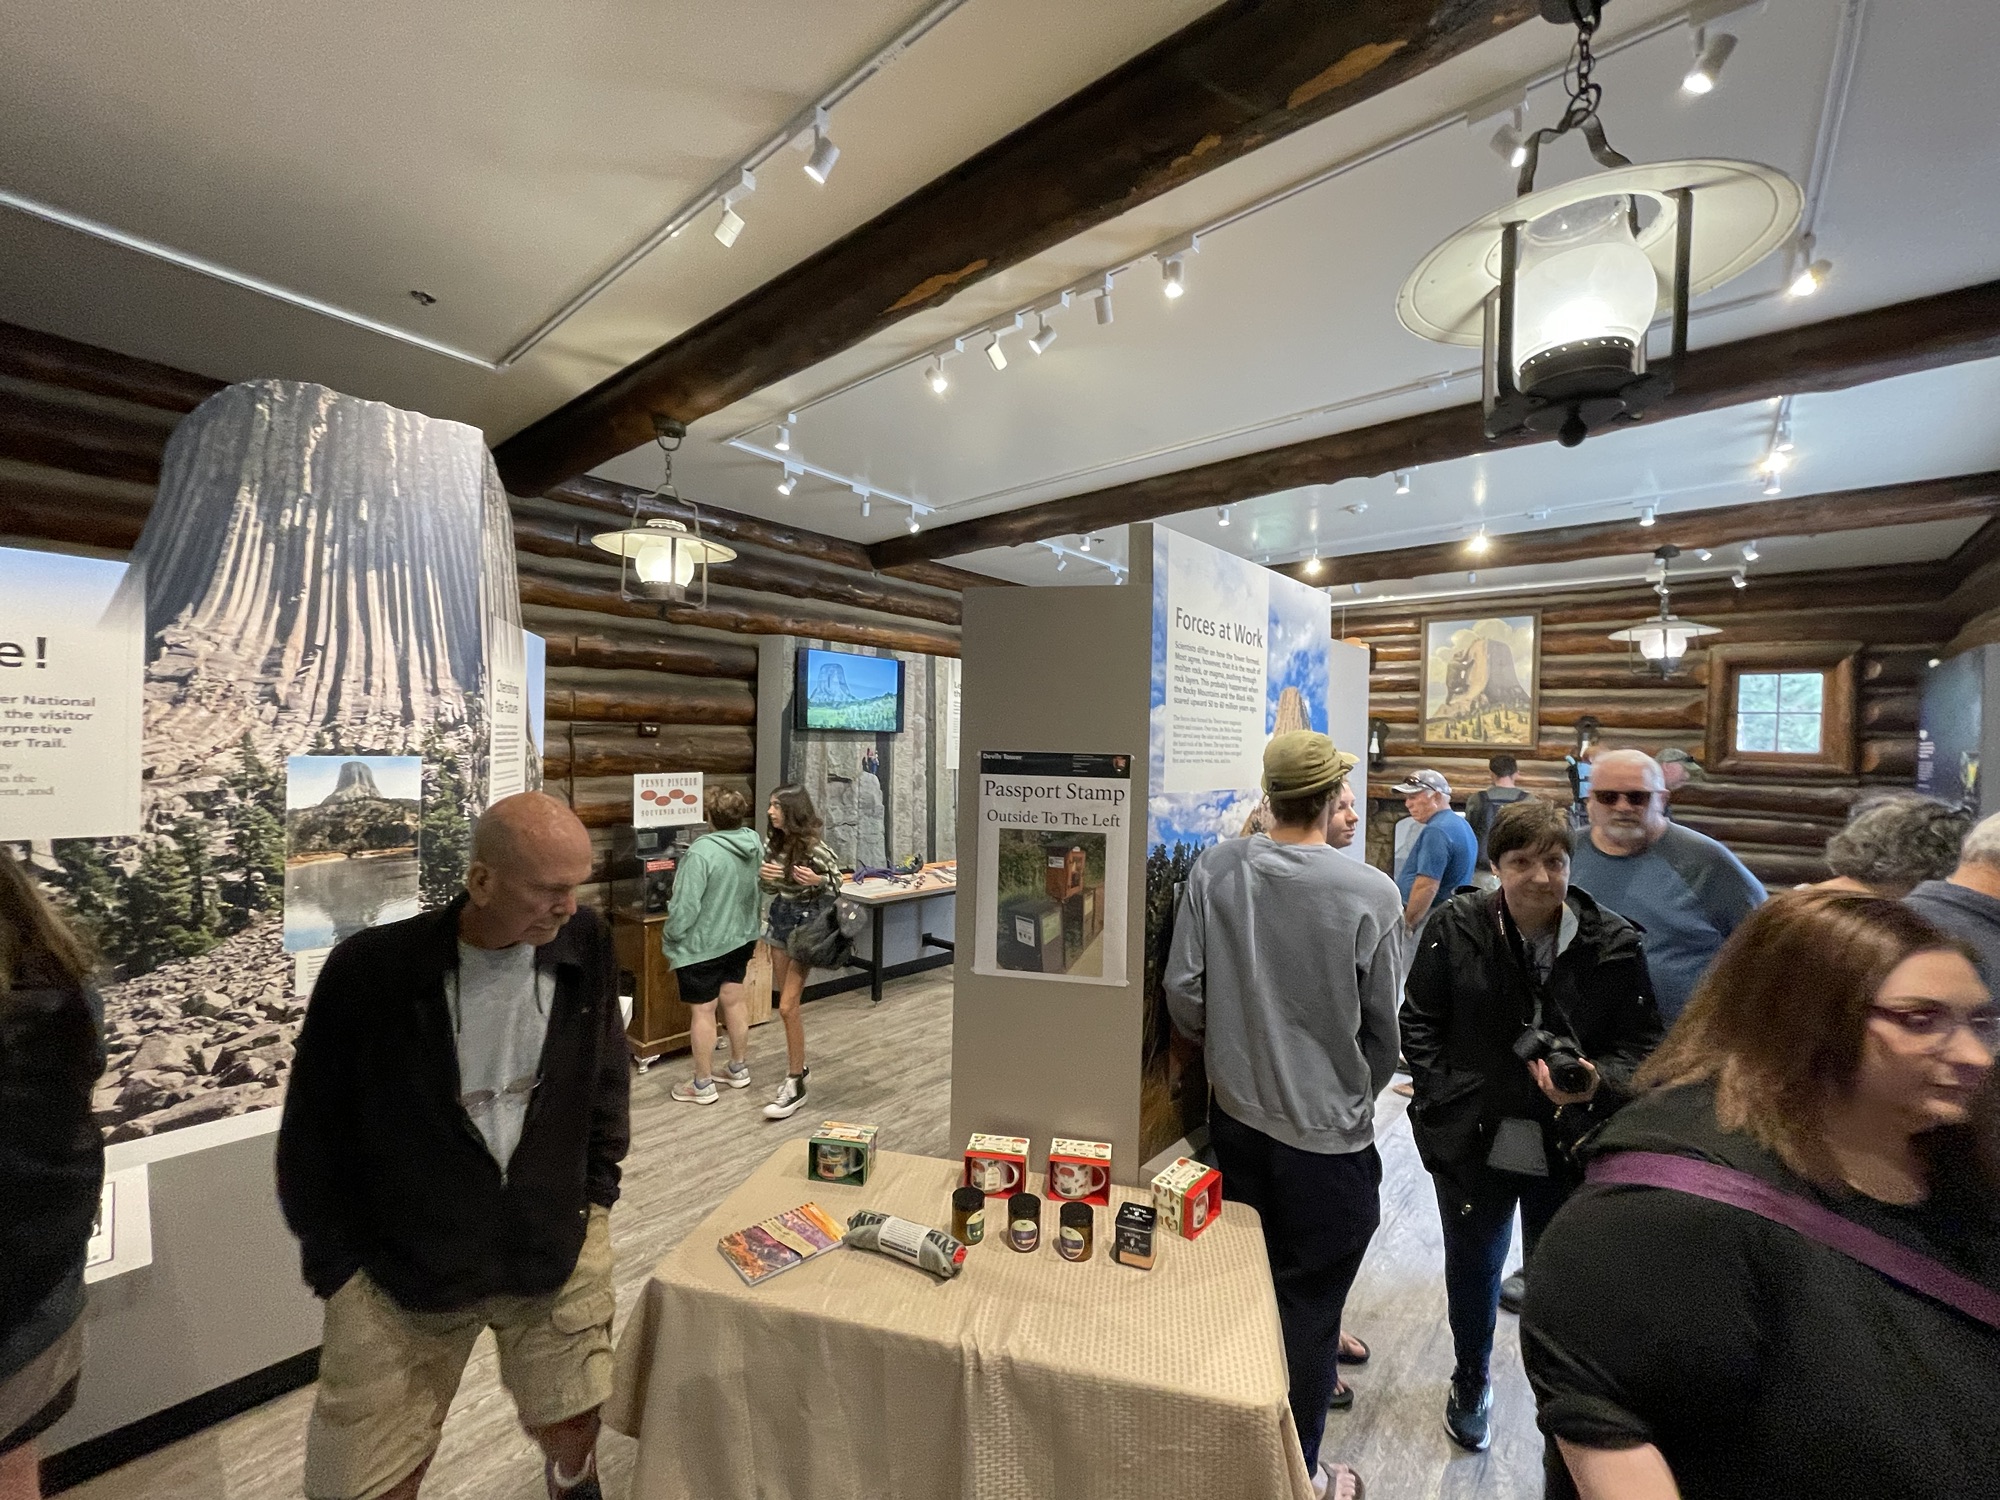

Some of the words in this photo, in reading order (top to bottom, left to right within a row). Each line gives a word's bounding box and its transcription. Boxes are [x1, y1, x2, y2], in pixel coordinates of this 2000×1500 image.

[1176, 607, 1215, 636] Forces
[1219, 621, 1230, 639] at
[1234, 623, 1263, 648] Work
[1175, 641, 1196, 652] Scientists
[1216, 650, 1225, 658] how
[1234, 653, 1245, 662] Tower
[1175, 652, 1187, 660] Most
[1202, 657, 1221, 668] however,
[1246, 666, 1256, 674] result
[1174, 664, 1190, 672] molten
[1226, 673, 1241, 683] pushing
[1201, 678, 1209, 686] This
[1210, 681, 1228, 690] probably
[1183, 687, 1196, 697] Rocky
[1197, 688, 1219, 697] Mountains
[23, 696, 95, 706] National
[1190, 699, 1207, 707] upward
[5, 709, 33, 719] the
[39, 710, 93, 720] visitor
[25, 738, 66, 748] Trail.
[641, 779, 664, 788] PENNY
[984, 780, 1062, 803] Passport
[1066, 782, 1125, 805] Stamp
[987, 809, 1038, 823] Outside
[1042, 811, 1058, 825] To
[1061, 812, 1088, 826] The
[1092, 814, 1120, 828] Left
